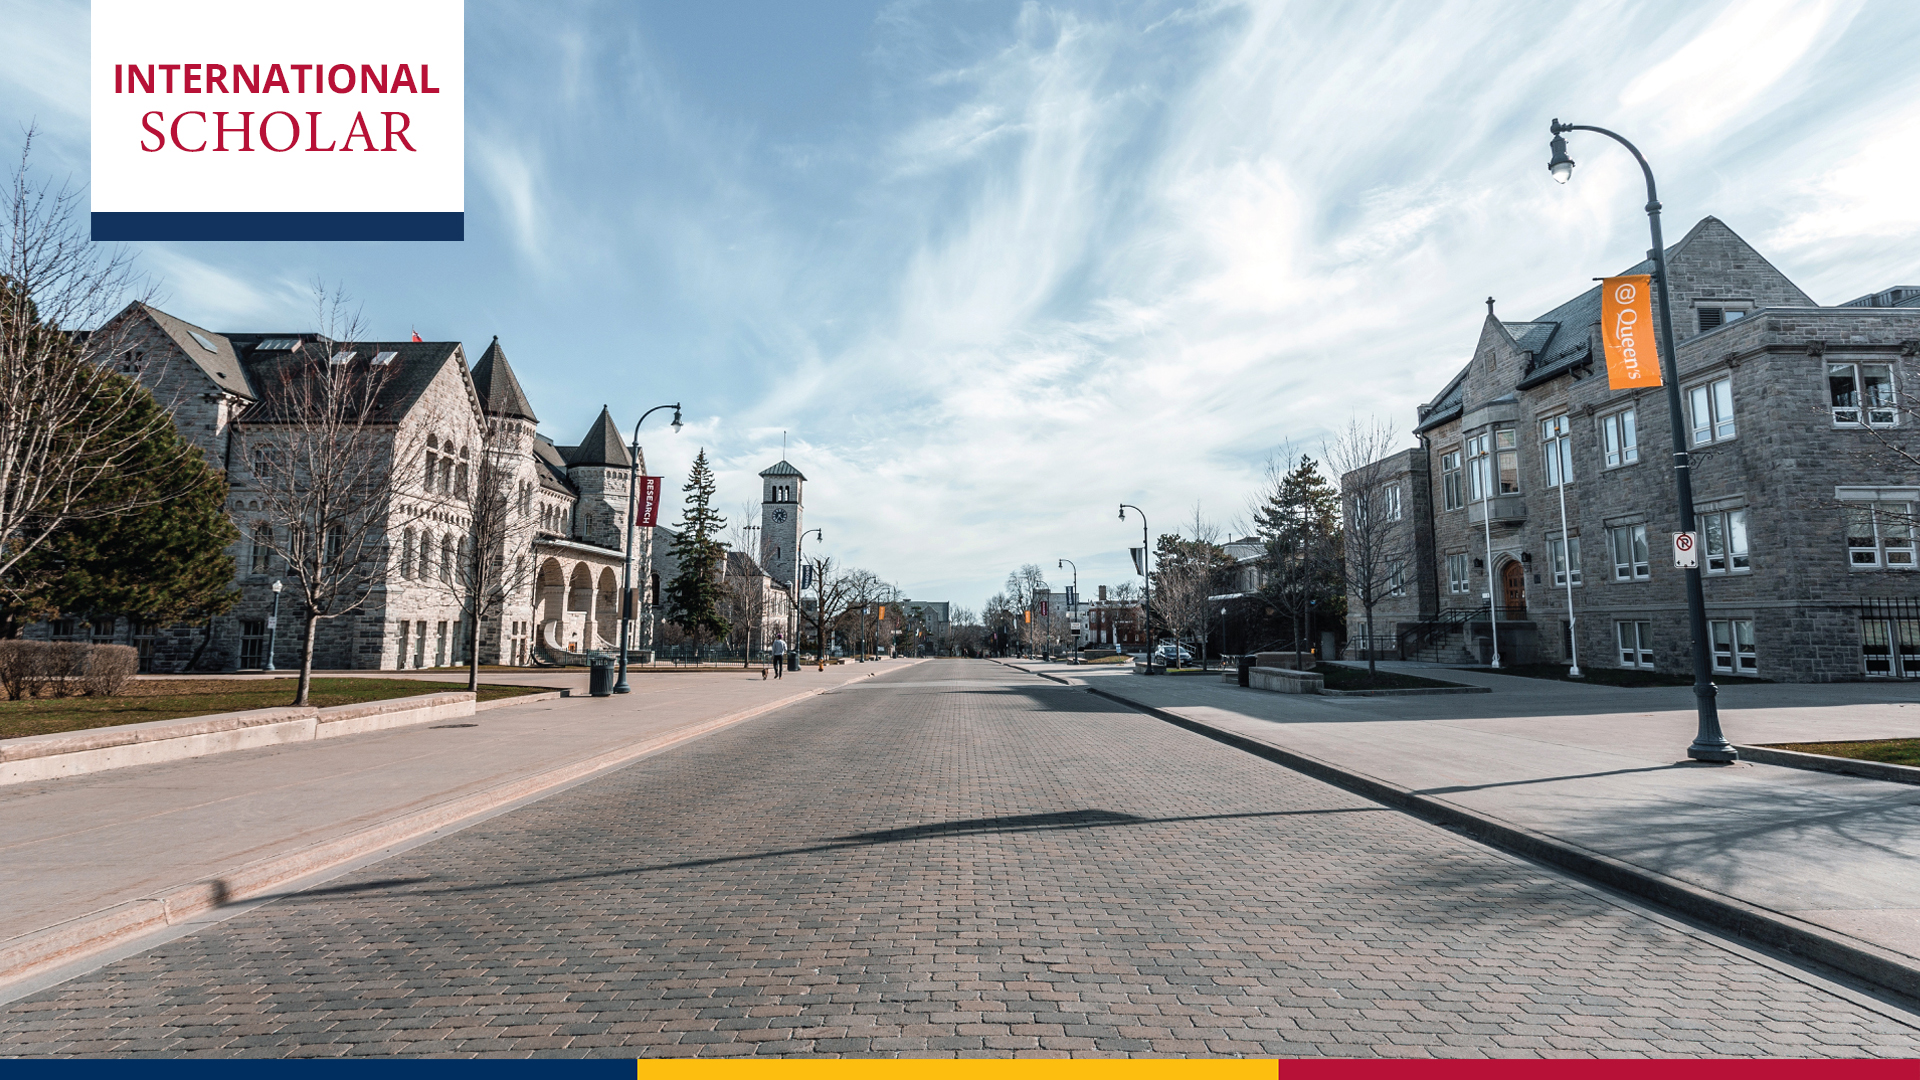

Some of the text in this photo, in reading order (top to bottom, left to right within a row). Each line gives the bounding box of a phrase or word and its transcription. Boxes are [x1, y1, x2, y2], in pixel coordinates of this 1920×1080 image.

[1615, 283, 1642, 380] @ Queen's
[642, 479, 655, 524] RESEARCH
